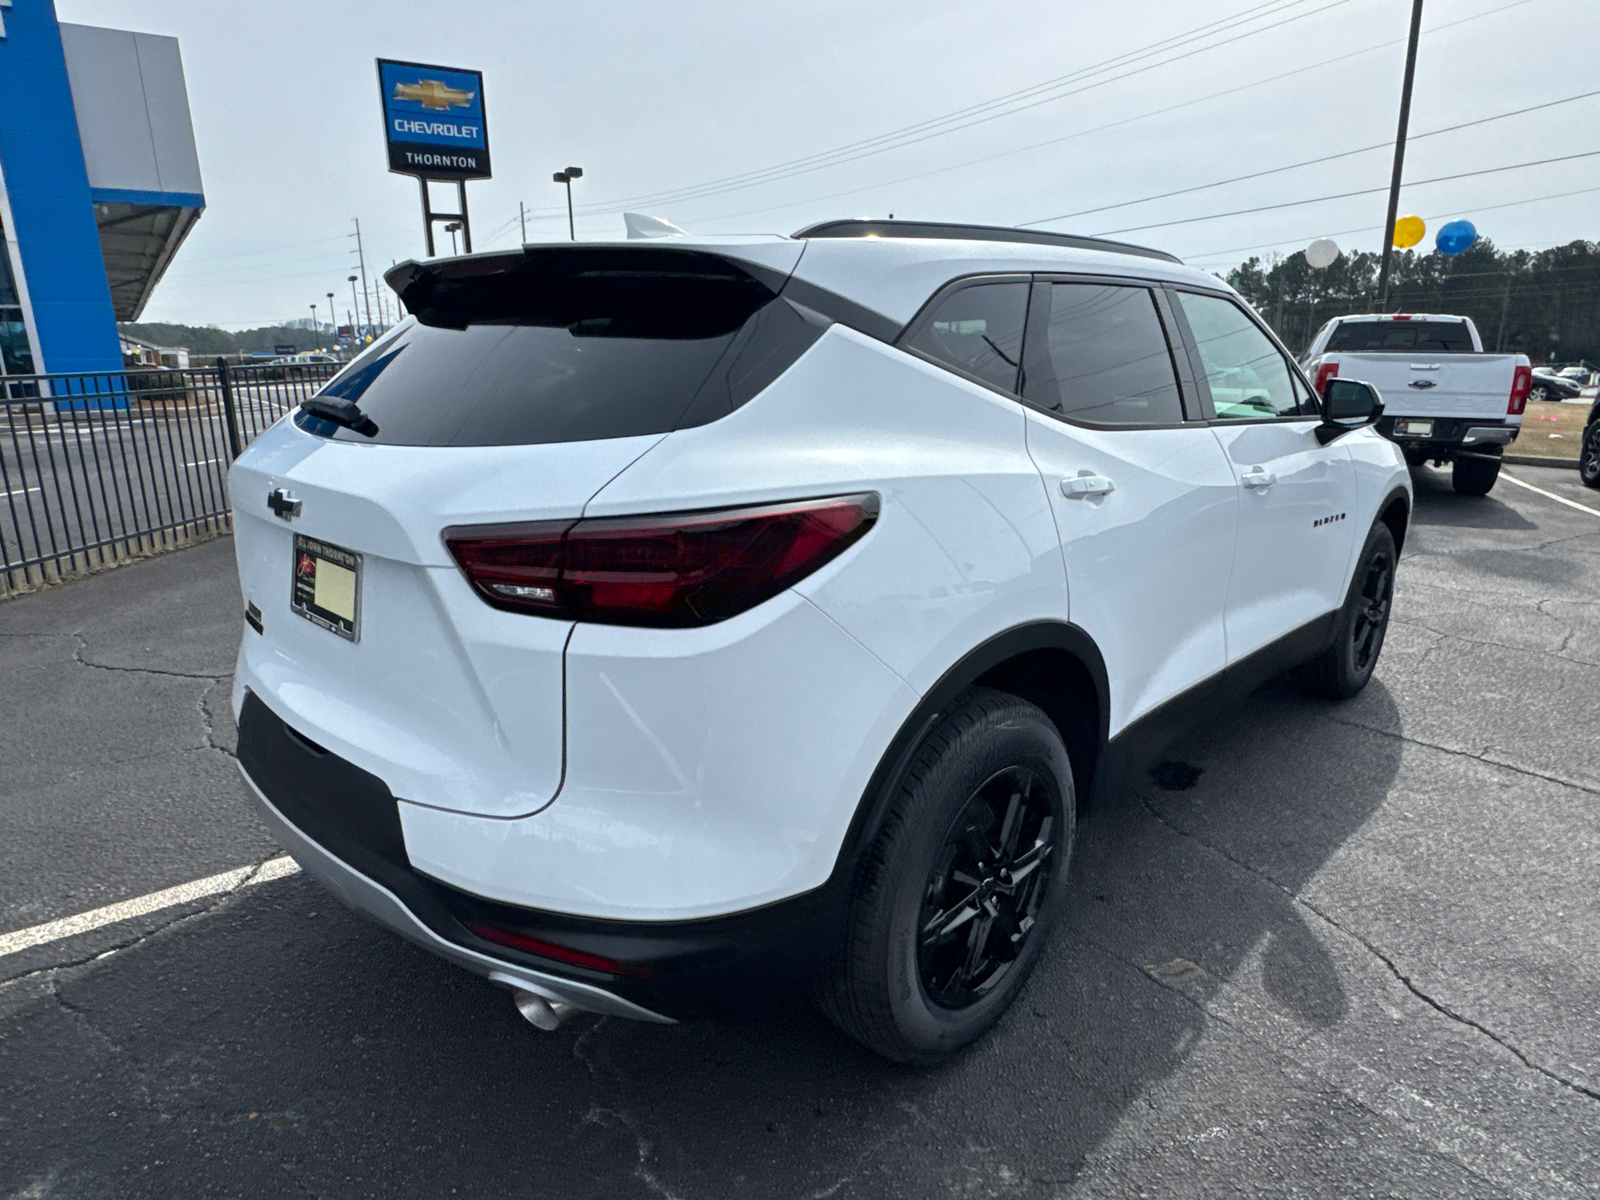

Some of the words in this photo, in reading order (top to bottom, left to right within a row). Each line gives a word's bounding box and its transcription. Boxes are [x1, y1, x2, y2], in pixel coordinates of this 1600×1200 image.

[394, 119, 479, 139] CHEVROLET
[405, 152, 477, 168] THORNTON
[322, 545, 355, 566] THORNTON
